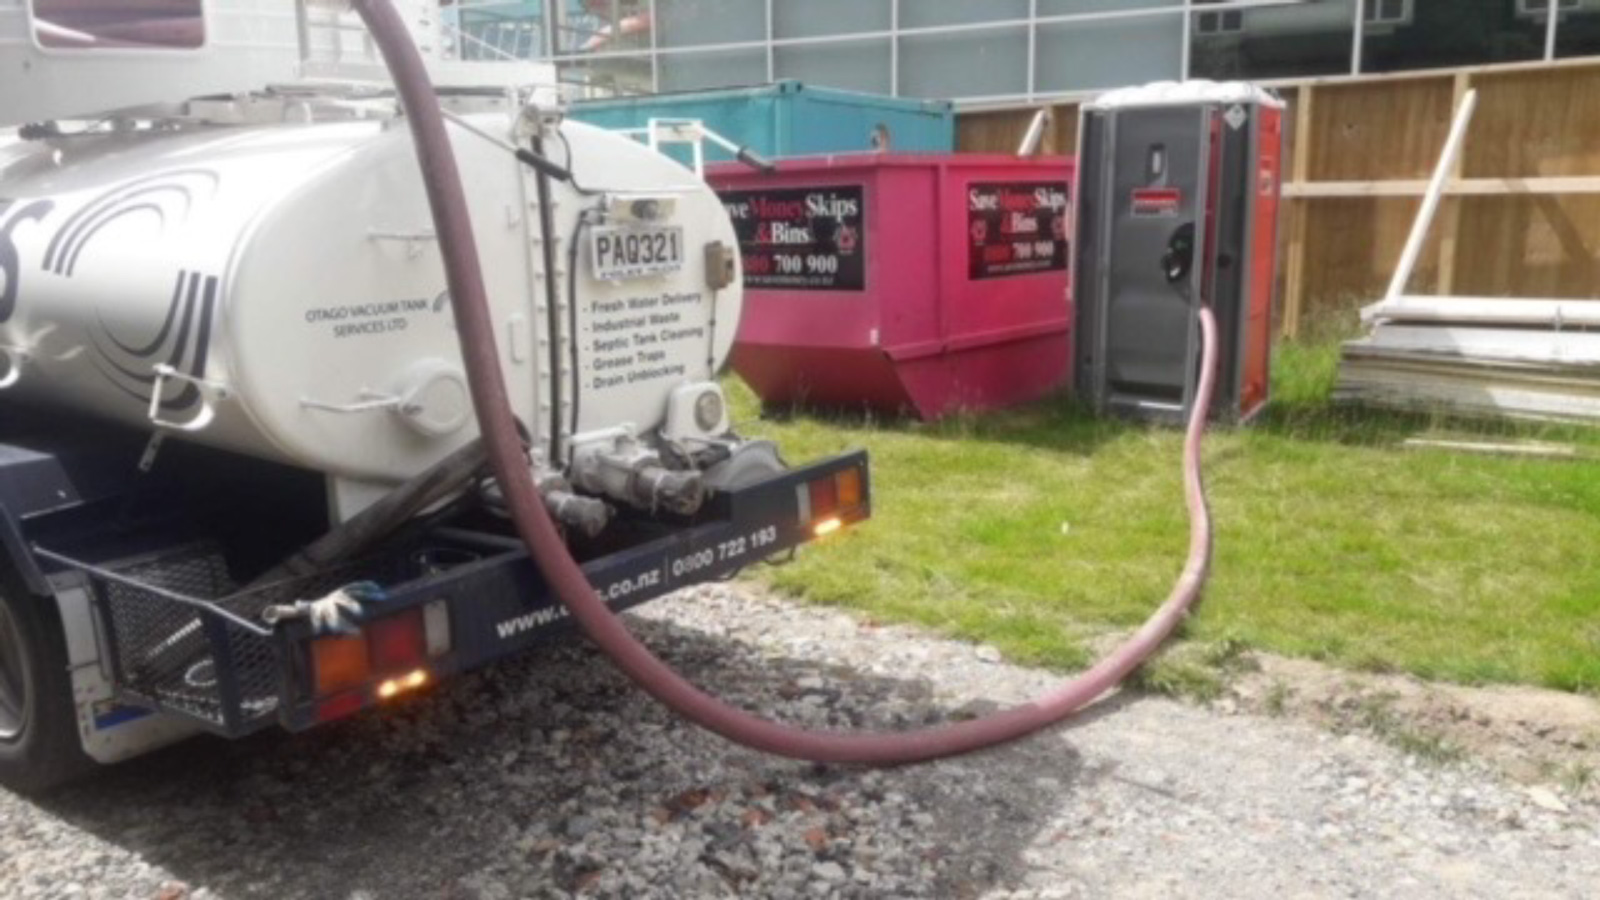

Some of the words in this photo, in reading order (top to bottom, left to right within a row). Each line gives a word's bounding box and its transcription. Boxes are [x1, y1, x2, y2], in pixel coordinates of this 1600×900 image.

[805, 192, 858, 223] Skips
[969, 188, 998, 211] Save
[1034, 187, 1067, 214] Skips
[596, 231, 678, 268] PAQ321
[773, 253, 802, 274] 700
[806, 253, 839, 274] 900
[305, 307, 349, 323] OTAGO
[350, 301, 399, 318] VACUUM
[400, 298, 429, 313] TANK
[592, 300, 625, 313] Fresh
[628, 297, 658, 310] Water
[661, 292, 702, 306] Delivery
[333, 319, 386, 338] SERVICES
[387, 316, 408, 332] LTD
[593, 316, 646, 333] Industrial
[649, 312, 680, 325] Waste
[593, 337, 629, 353] Septic
[632, 333, 657, 345] Tank
[660, 327, 703, 342] Cleaning
[593, 356, 633, 371] Grease
[637, 350, 666, 364] Traps
[593, 375, 625, 389] Drain
[627, 365, 684, 384] Unblocking
[672, 547, 714, 577] 0800
[717, 536, 747, 560] 722
[750, 525, 777, 549] 193
